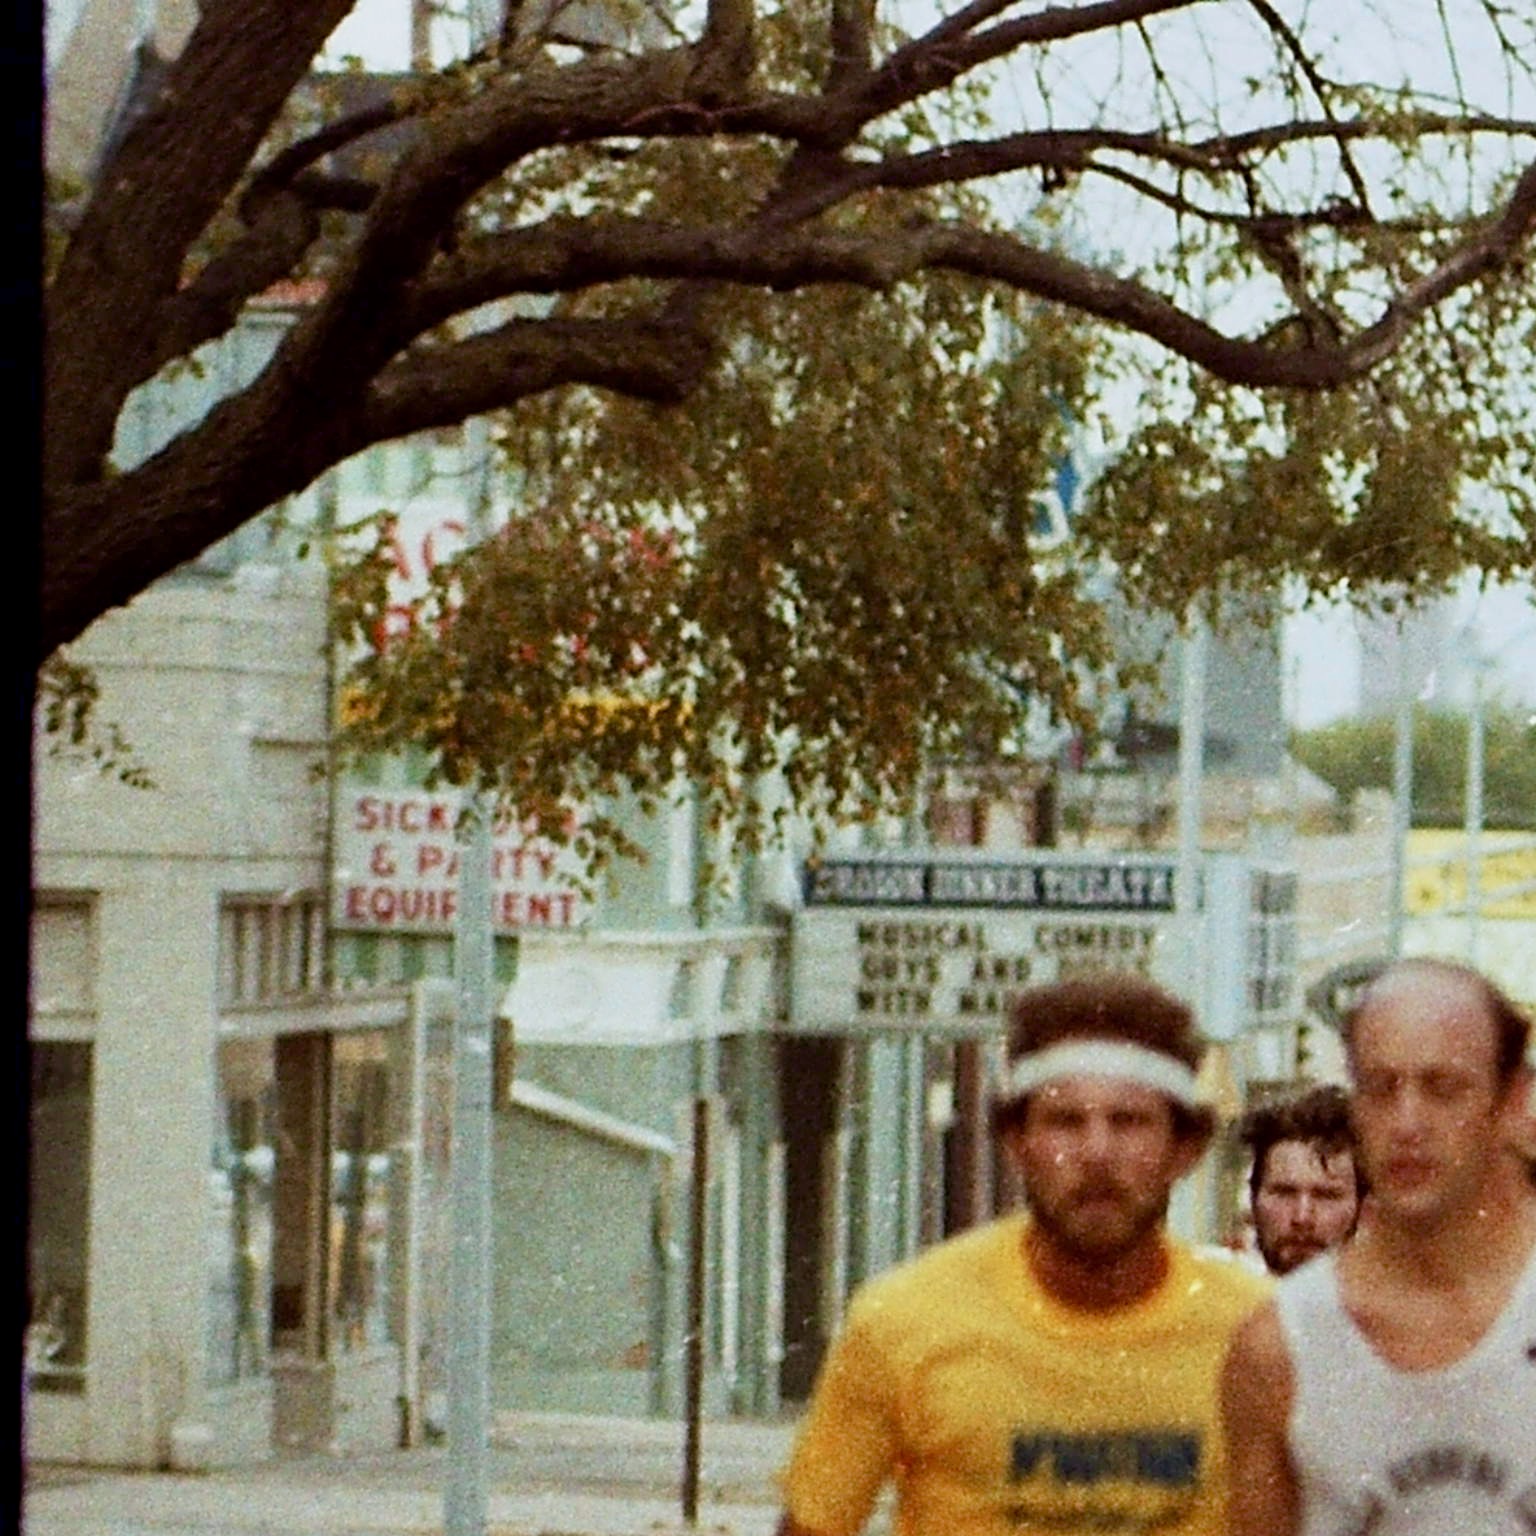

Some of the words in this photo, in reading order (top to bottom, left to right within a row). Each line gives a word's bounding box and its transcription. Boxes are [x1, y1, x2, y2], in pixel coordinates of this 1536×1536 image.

[346, 885, 575, 928] EQUIPENT
[857, 922, 988, 950] MUSICAL
[1035, 924, 1156, 951] COMEDY
[861, 955, 941, 982] GUYS
[972, 957, 1031, 982] AND
[856, 988, 930, 1014] WITH
